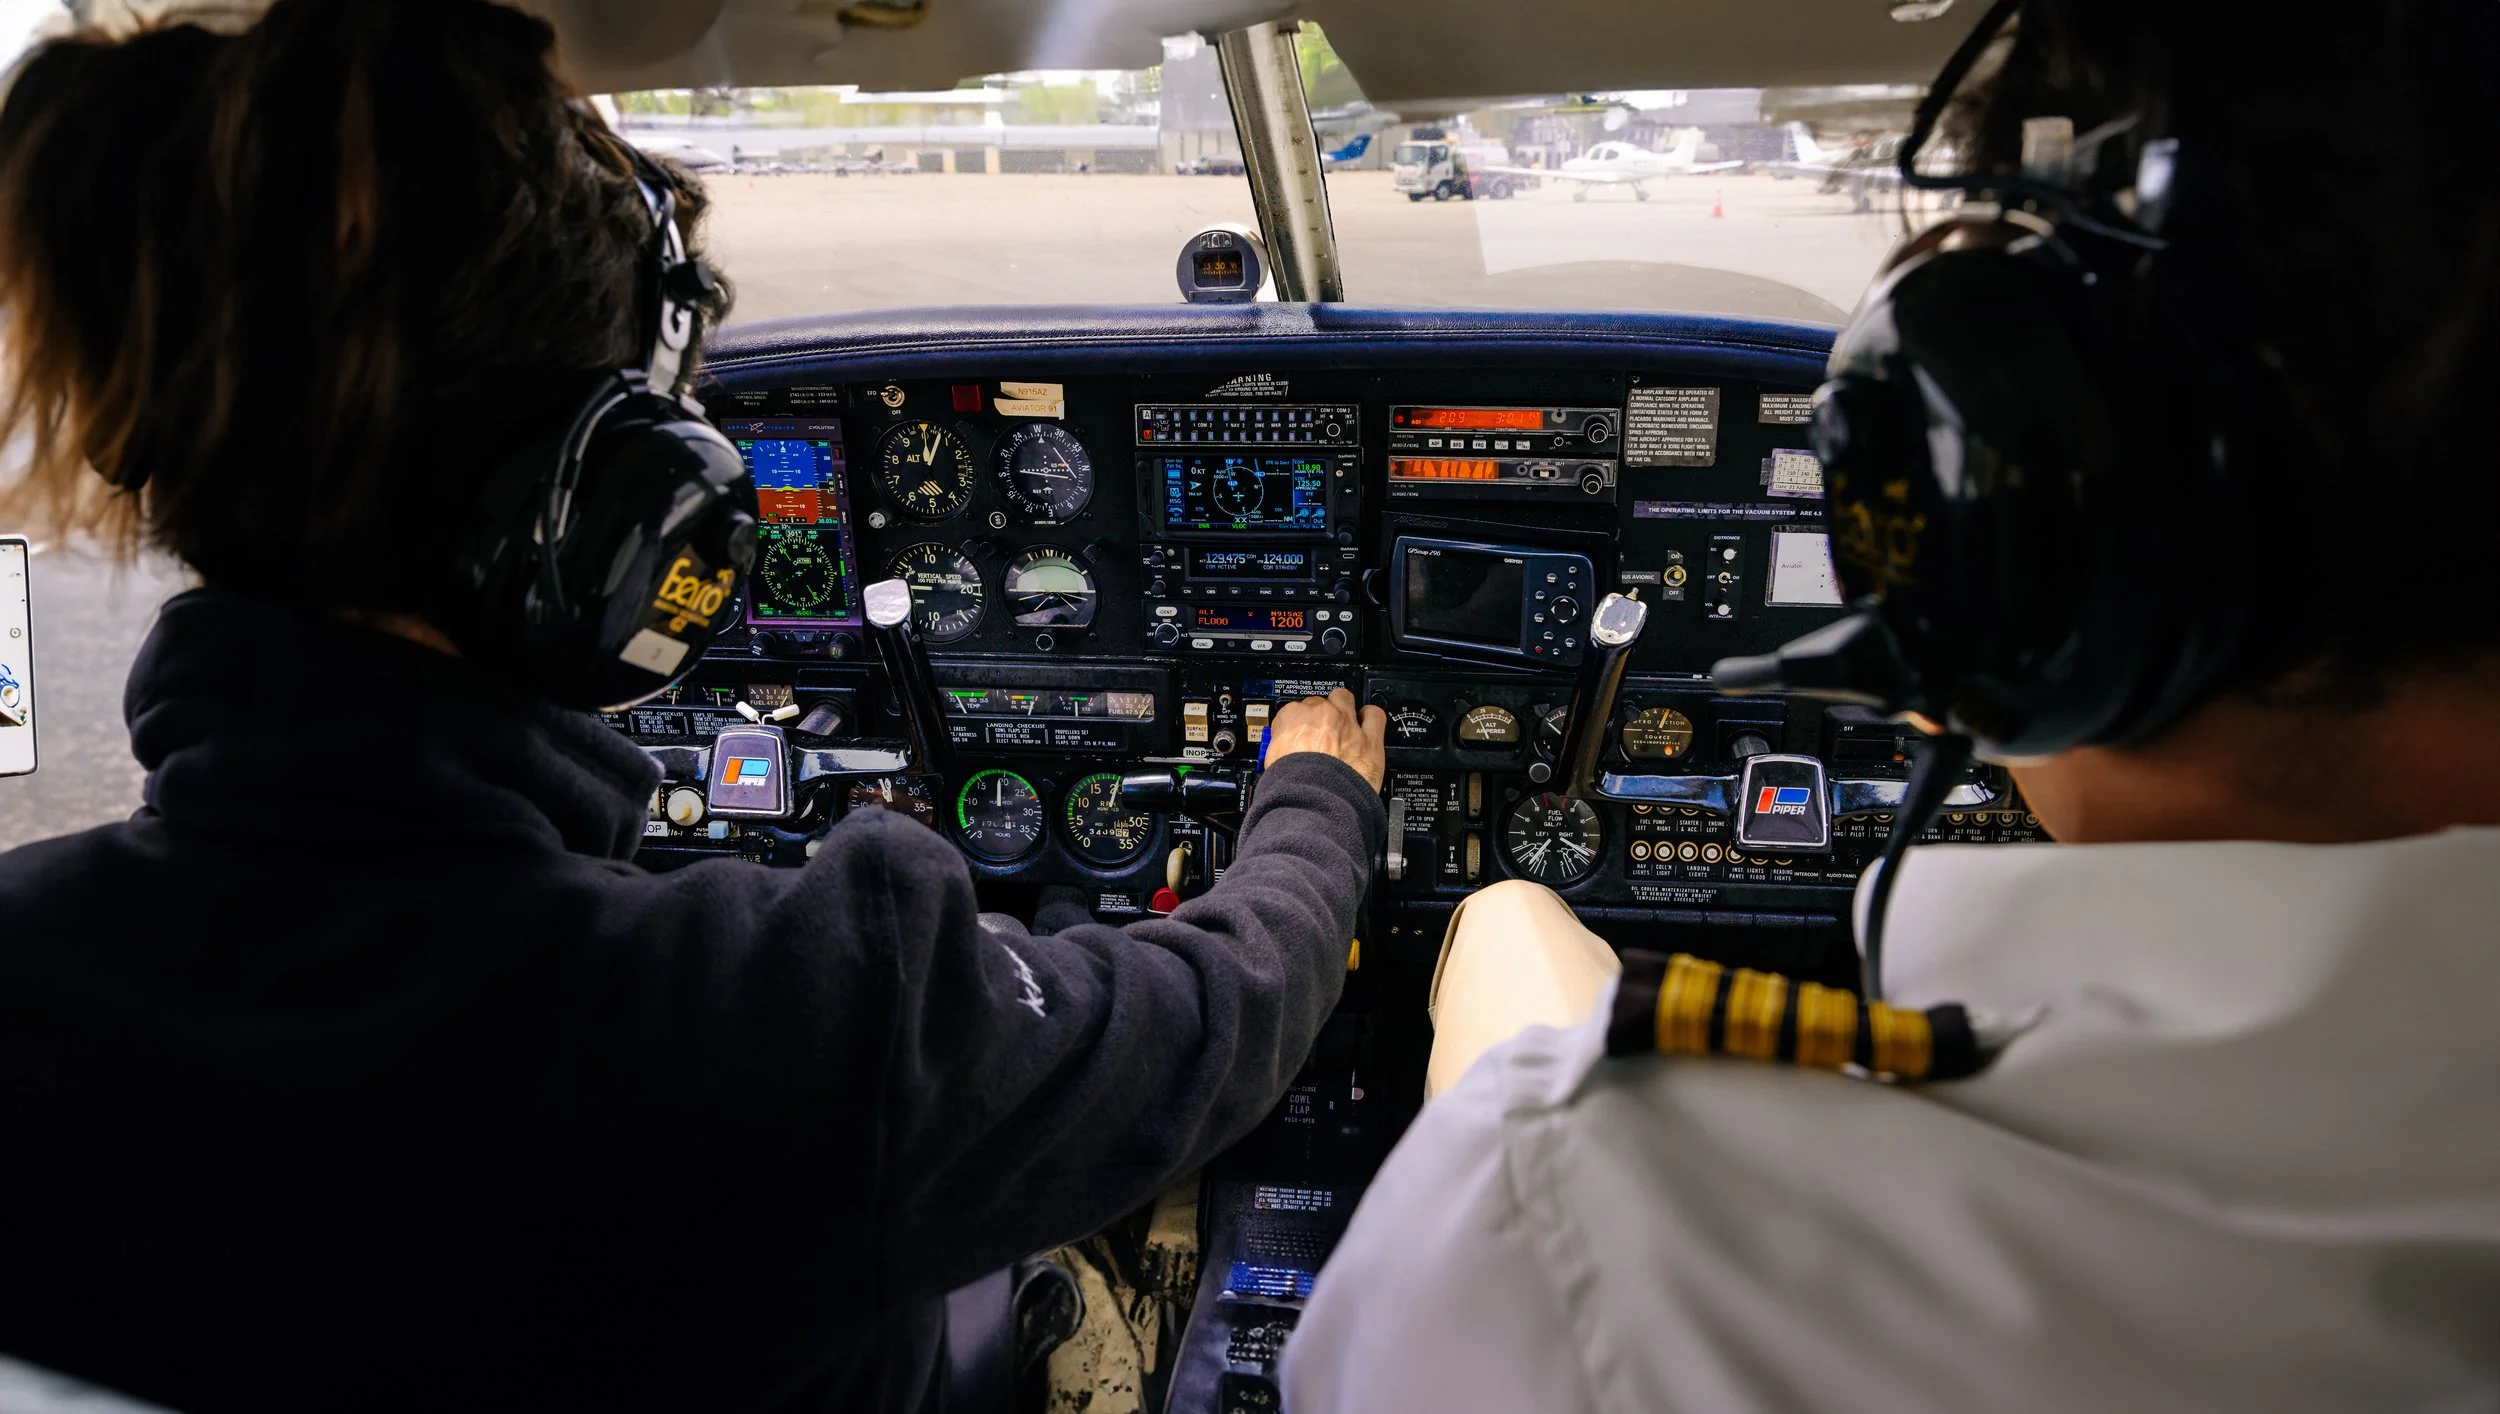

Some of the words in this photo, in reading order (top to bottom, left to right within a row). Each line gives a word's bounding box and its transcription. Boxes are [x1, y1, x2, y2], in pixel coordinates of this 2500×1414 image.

[1214, 262, 1225, 270] 30
[1227, 374, 1272, 384] ARNING
[1440, 412, 1465, 423] 209
[1033, 425, 1041, 433] W
[1054, 428, 1064, 437] 30
[1012, 432, 1022, 441] 24
[902, 438, 910, 447] 9
[1072, 442, 1082, 452] 33
[955, 450, 962, 460] 2
[1001, 449, 1009, 458] 21
[892, 455, 899, 465] 8
[893, 475, 900, 485] 7
[959, 477, 966, 487] 3
[908, 492, 916, 501] 6
[948, 491, 956, 500] 4
[929, 498, 936, 508] 5
[925, 554, 936, 564] 10
[1205, 553, 1246, 564] 129.475
[1263, 554, 1304, 564] 124.000
[960, 585, 973, 594] 20
[929, 612, 940, 621] 10
[1198, 617, 1228, 625] FL000
[1270, 617, 1303, 627] 1200
[738, 777, 766, 786] PIPER
[866, 785, 874, 793] 15
[908, 788, 919, 796] 30
[1090, 784, 1101, 794] 15
[914, 803, 926, 811] 35
[1078, 797, 1089, 808] 10
[1772, 805, 1806, 815] PIPER
[1076, 815, 1083, 825] 5
[1129, 817, 1143, 827] 30
[1083, 837, 1090, 848] 0
[1119, 839, 1133, 849] 35
[1290, 1095, 1310, 1104] COWL
[1290, 1105, 1310, 1114] FLAP
[1329, 1101, 1334, 1110] R
